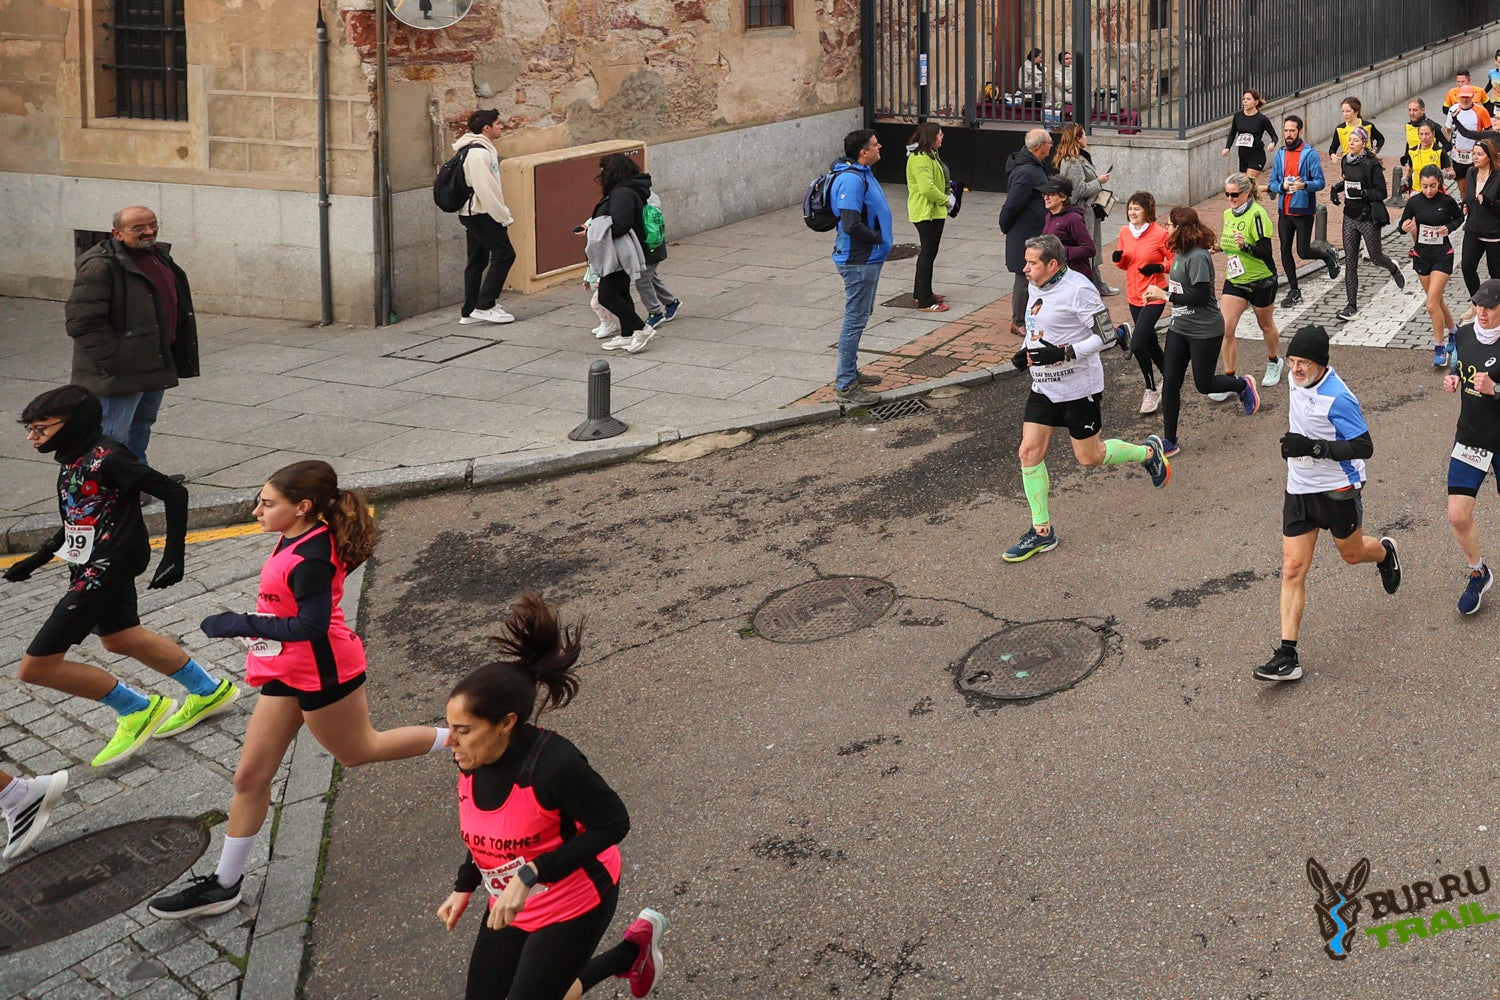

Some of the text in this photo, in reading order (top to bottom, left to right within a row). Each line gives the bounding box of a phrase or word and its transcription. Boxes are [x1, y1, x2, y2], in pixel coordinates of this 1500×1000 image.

[1423, 229, 1440, 238] 211
[473, 834, 486, 847] DE
[489, 833, 541, 851] TORMES
